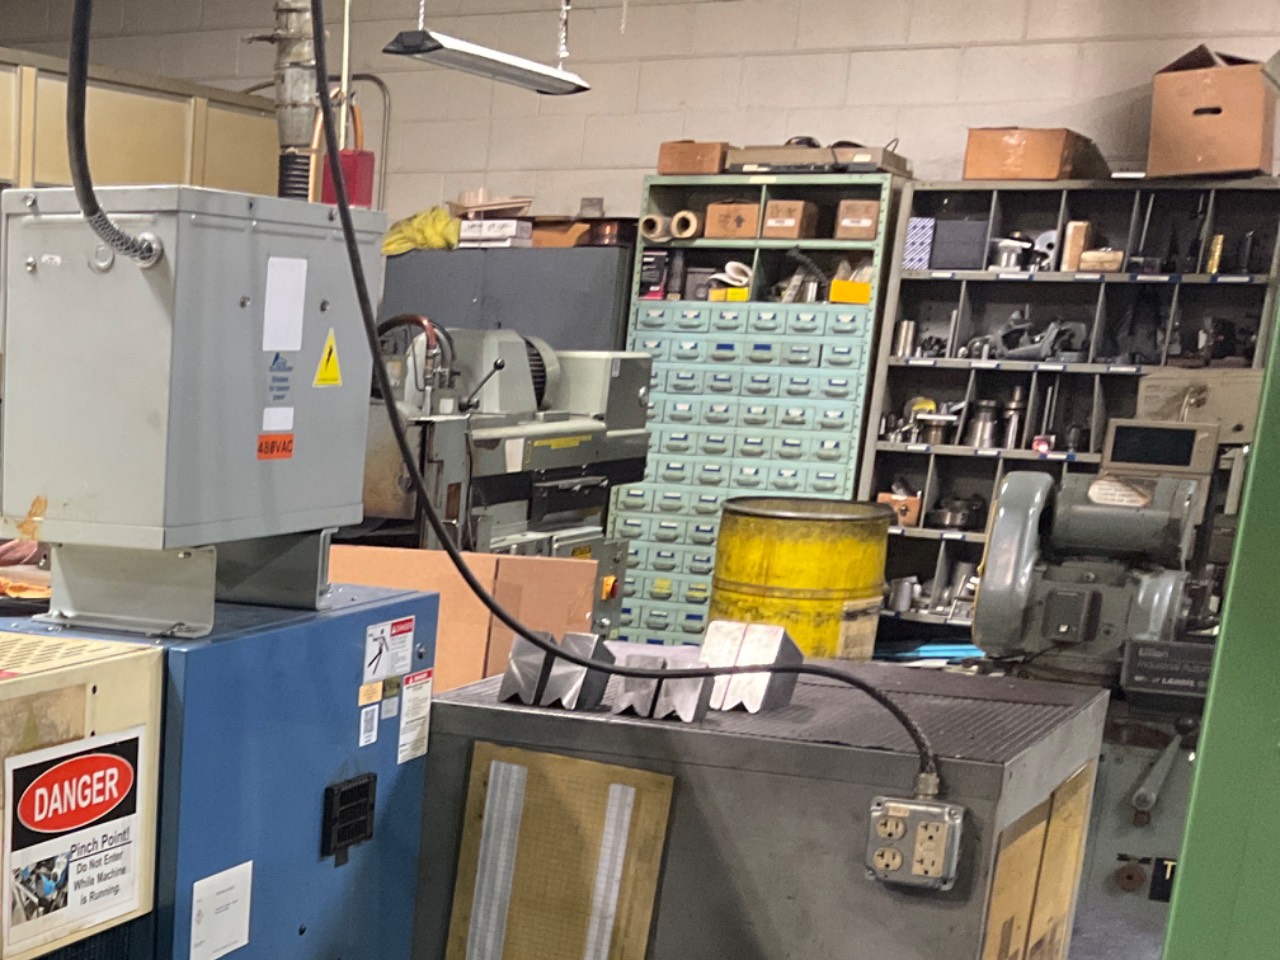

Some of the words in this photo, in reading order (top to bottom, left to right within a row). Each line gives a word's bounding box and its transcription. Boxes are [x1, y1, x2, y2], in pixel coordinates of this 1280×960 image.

[33, 766, 119, 823] DANGER
[70, 837, 99, 859] Pinch
[101, 826, 131, 851] Point!
[76, 861, 87, 874] Do
[89, 855, 103, 870] Not
[103, 850, 124, 865] Enter
[73, 876, 95, 891] While
[96, 865, 127, 883] Machine
[79, 893, 88, 905] is
